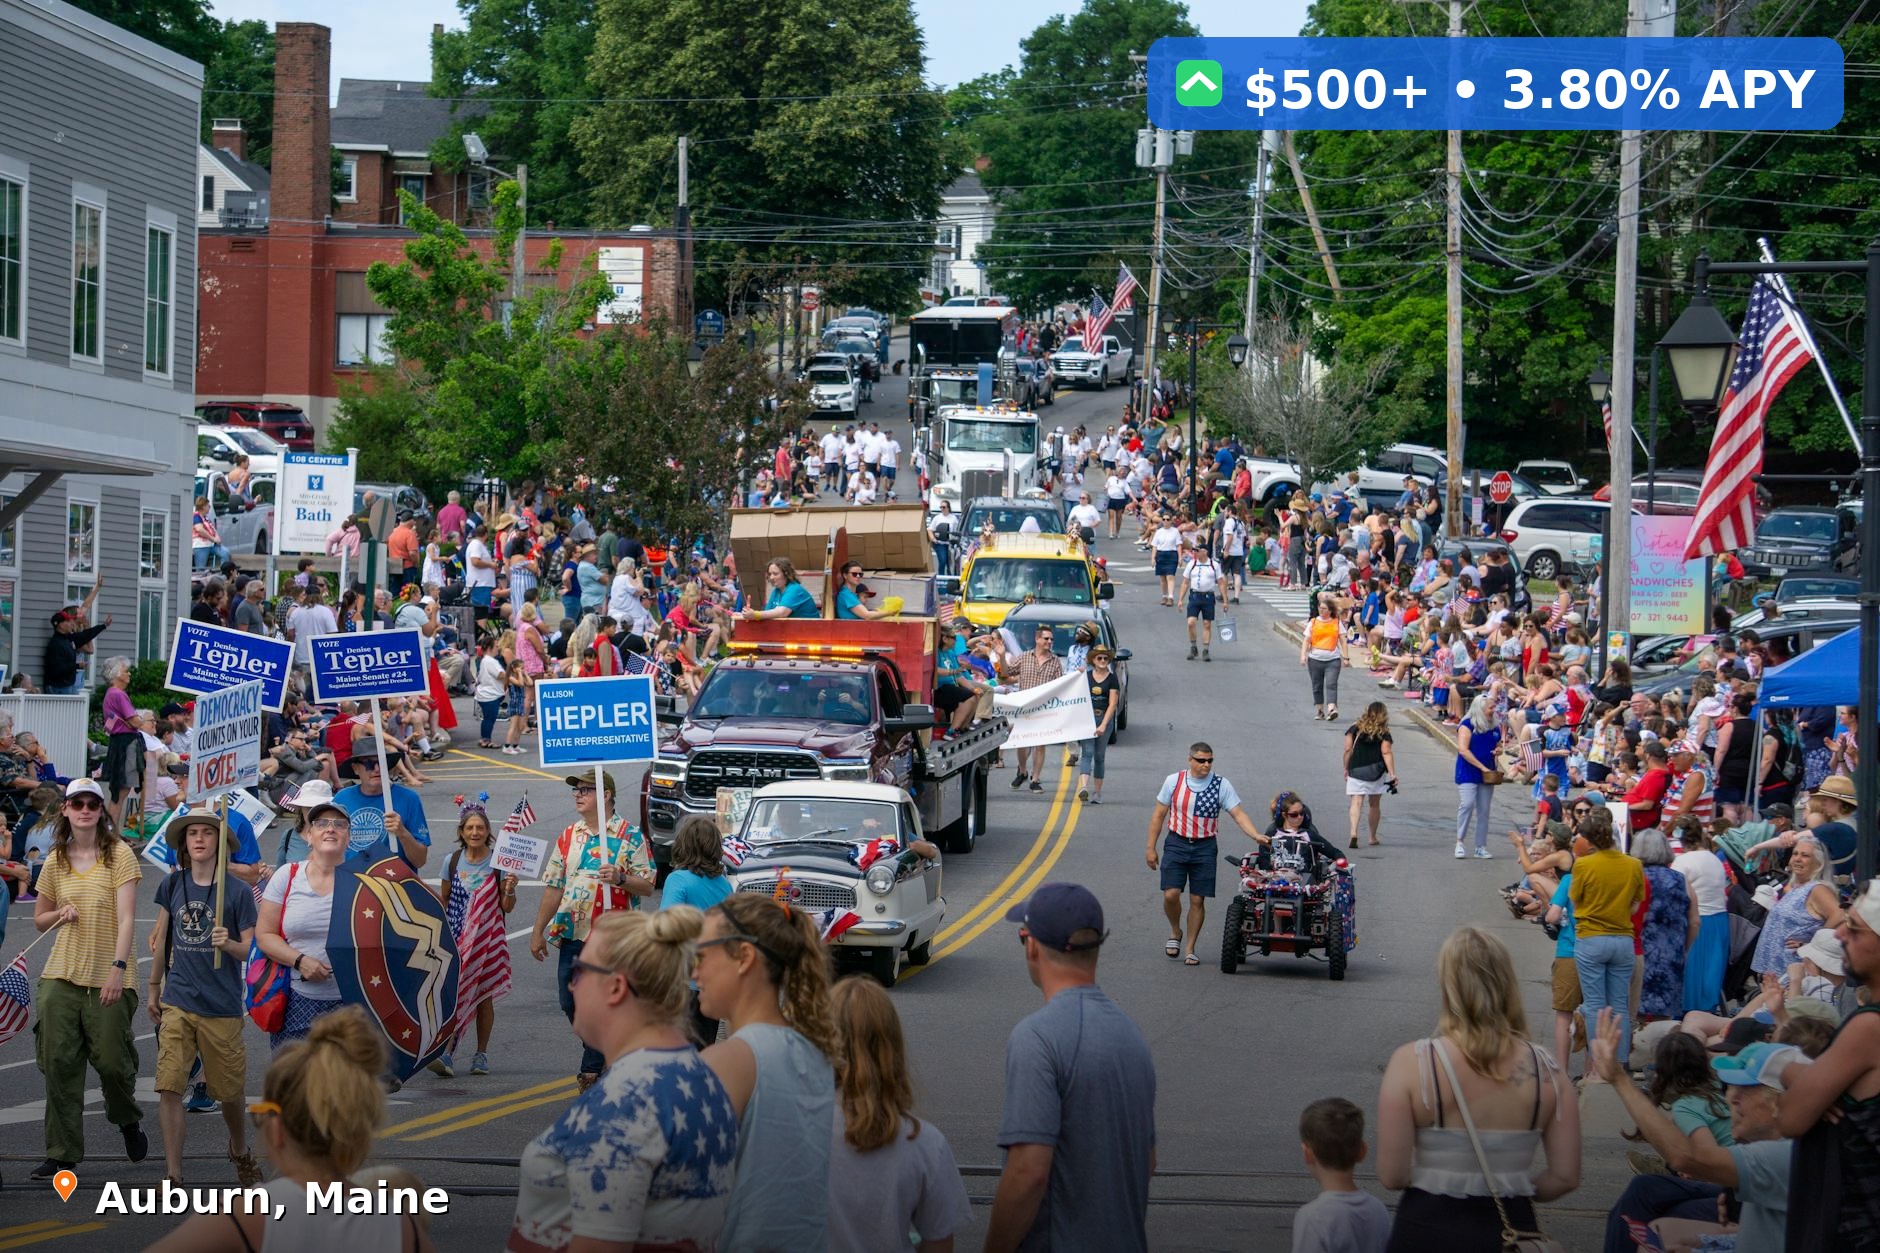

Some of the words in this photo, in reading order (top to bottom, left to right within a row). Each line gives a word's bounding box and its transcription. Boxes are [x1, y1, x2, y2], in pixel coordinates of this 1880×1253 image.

[291, 455, 306, 463] 108
[1491, 481, 1511, 494] STOP
[296, 508, 332, 522] Bath
[1630, 578, 1694, 587] ANDWICHES
[1630, 613, 1641, 621] 07
[1648, 614, 1661, 622] 321
[187, 626, 210, 638] VOTE
[214, 641, 239, 652] Denise
[190, 640, 277, 676] Tepler
[324, 647, 412, 672] Tepler
[192, 666, 219, 679] Maine
[542, 690, 573, 699] ALLISON
[200, 685, 259, 728] DEMOCRACY
[545, 702, 649, 731] HEPLER
[198, 724, 225, 751] COUNTS
[227, 722, 237, 742] ON
[240, 716, 259, 739] YOUR
[546, 738, 572, 748] STATE
[574, 733, 649, 746] REPRESENTATIVE
[196, 752, 237, 794] VOTE!
[726, 768, 782, 777] RAM
[509, 837, 536, 846] WOMEN'S
[510, 843, 532, 851] RIGHTS
[500, 846, 517, 857] COUNTS
[526, 852, 538, 860] YOUR
[497, 855, 523, 870] VOTE!
